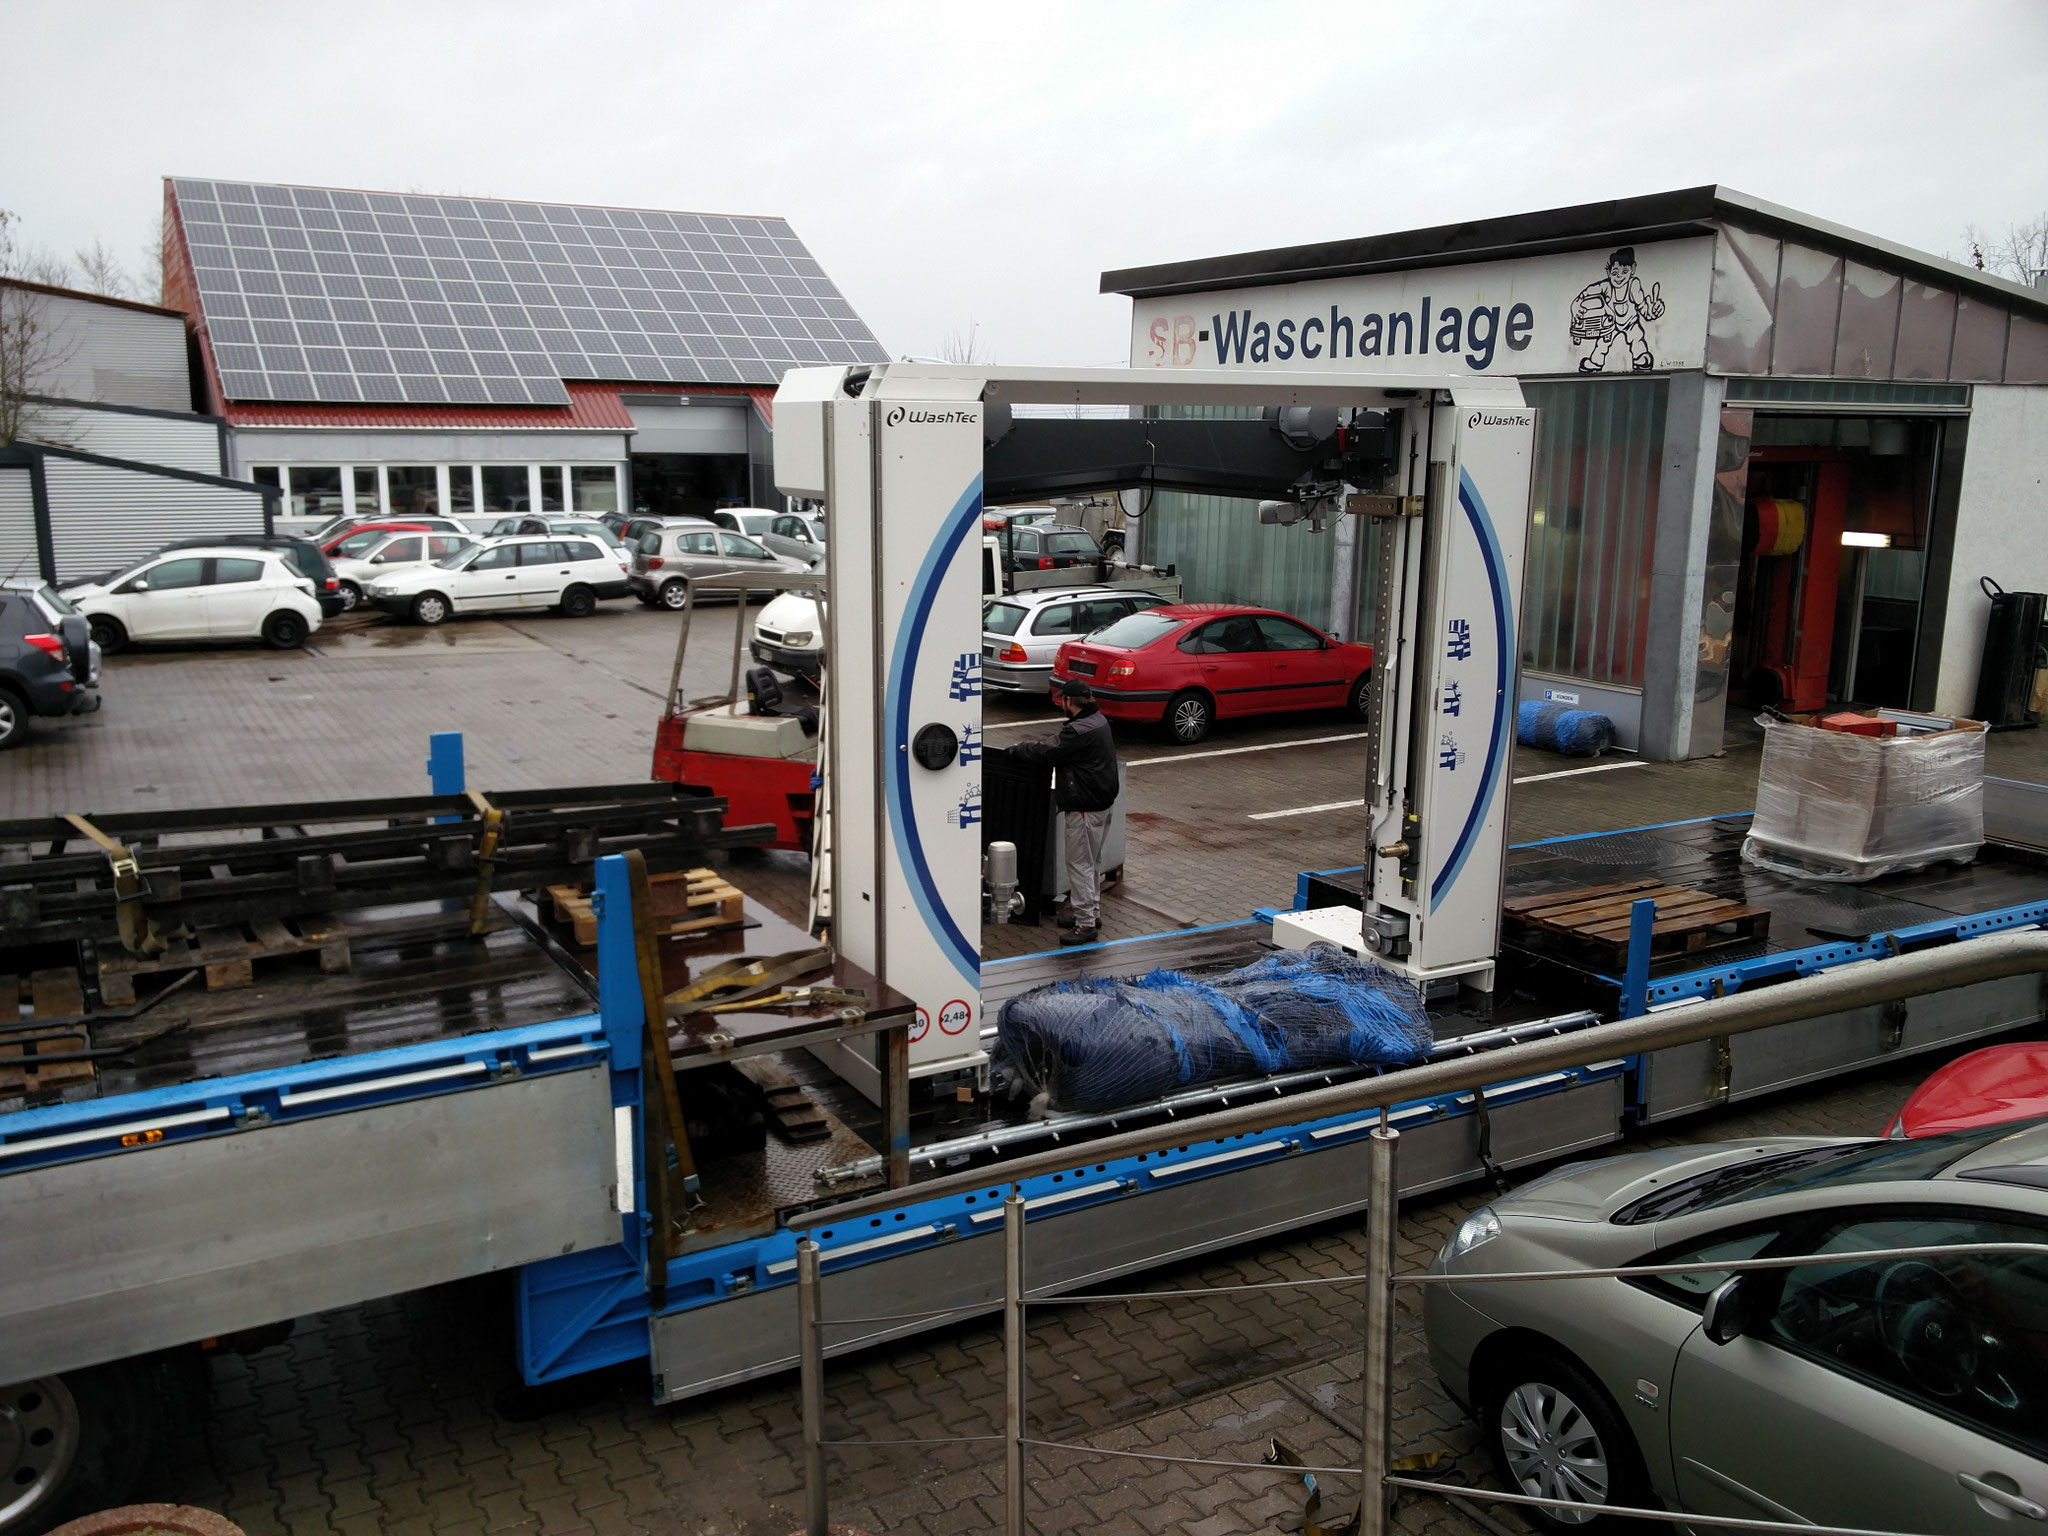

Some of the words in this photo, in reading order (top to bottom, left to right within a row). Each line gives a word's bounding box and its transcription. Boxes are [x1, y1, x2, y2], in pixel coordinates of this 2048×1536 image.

[908, 410, 978, 424] WashTec
[1483, 415, 1531, 426] WashTec
[943, 1011, 965, 1024] 2,48
